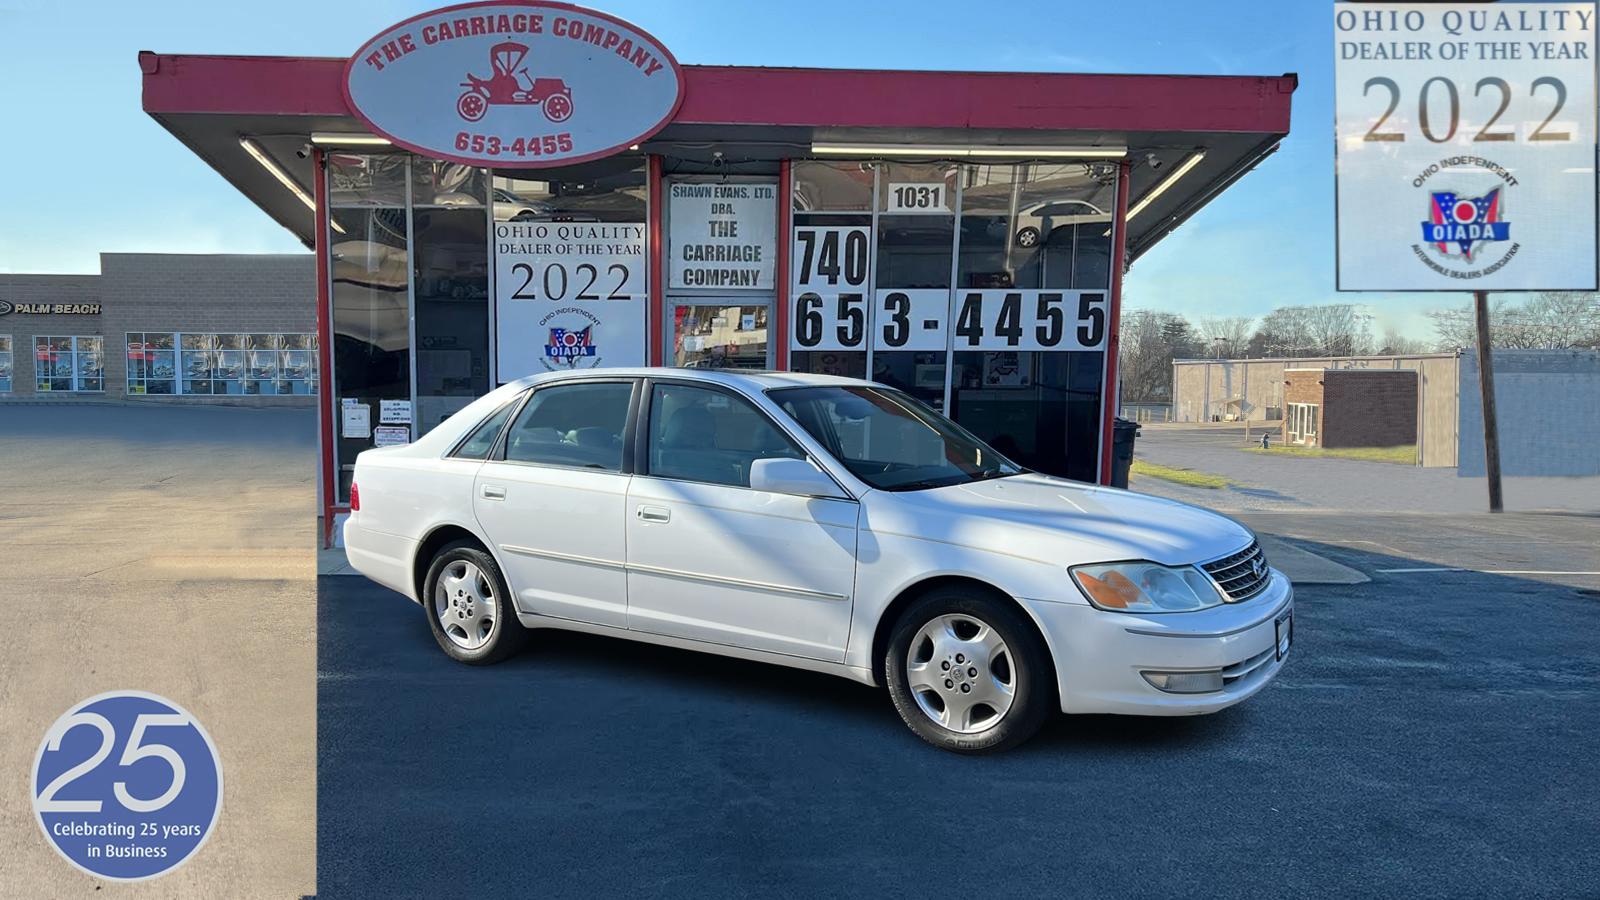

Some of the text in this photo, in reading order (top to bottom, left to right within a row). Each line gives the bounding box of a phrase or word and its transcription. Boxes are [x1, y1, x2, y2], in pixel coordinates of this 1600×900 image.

[1336, 10, 1593, 35] OHIO QUALITY
[365, 14, 664, 77] THE CARRIAGE COMPANY
[1341, 41, 1589, 60] DEALER OF THE YEAR
[1363, 76, 1571, 143] 2022
[455, 132, 573, 156] 653-4455
[1413, 156, 1519, 188] OHIO INDEPENDENT
[672, 186, 713, 198] SHAWN
[754, 187, 775, 199] LTD.
[894, 187, 940, 208] 1031
[711, 203, 735, 215] DBA.
[497, 226, 644, 241] OHIO QUALITY
[708, 221, 738, 237] THE
[1433, 225, 1494, 240] OIADA
[500, 244, 641, 255] DEALER OF THE YEAR
[683, 245, 762, 262] CARRIAGE
[798, 231, 867, 285] 740
[1411, 244, 1449, 277] AUTOMOBILE
[1450, 269, 1482, 280] DEALERS
[511, 263, 631, 301] 2022
[683, 268, 760, 286] COMPANY
[15, 304, 100, 314] PALM BEACH
[539, 307, 601, 326] OHIO INDEPENDENT
[551, 346, 587, 356] OIADA
